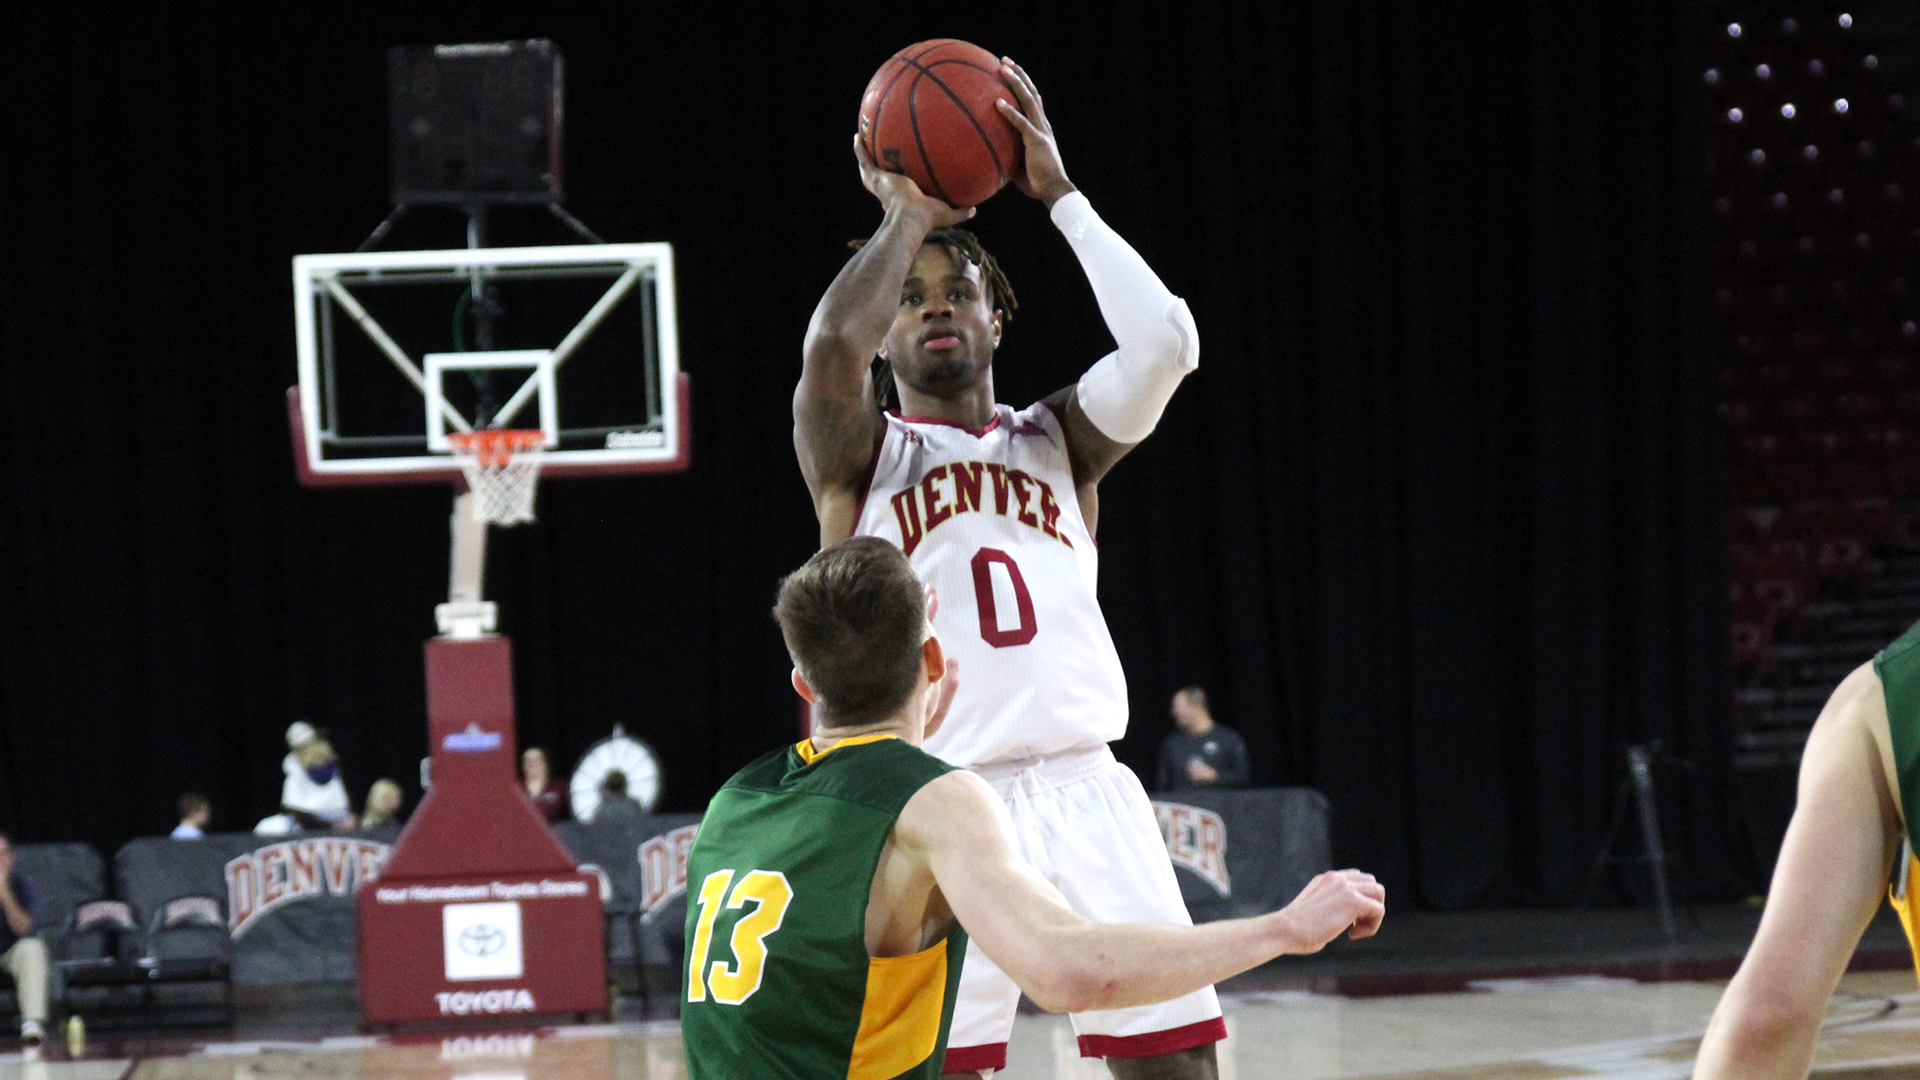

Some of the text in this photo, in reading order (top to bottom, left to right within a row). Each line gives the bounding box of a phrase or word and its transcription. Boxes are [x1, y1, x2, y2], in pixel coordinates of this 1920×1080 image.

[891, 460, 1075, 558] DENVER
[971, 547, 1038, 649] 0
[225, 837, 393, 940] DENVE
[688, 868, 794, 1006] 13
[435, 989, 536, 1015] TOYOTA
